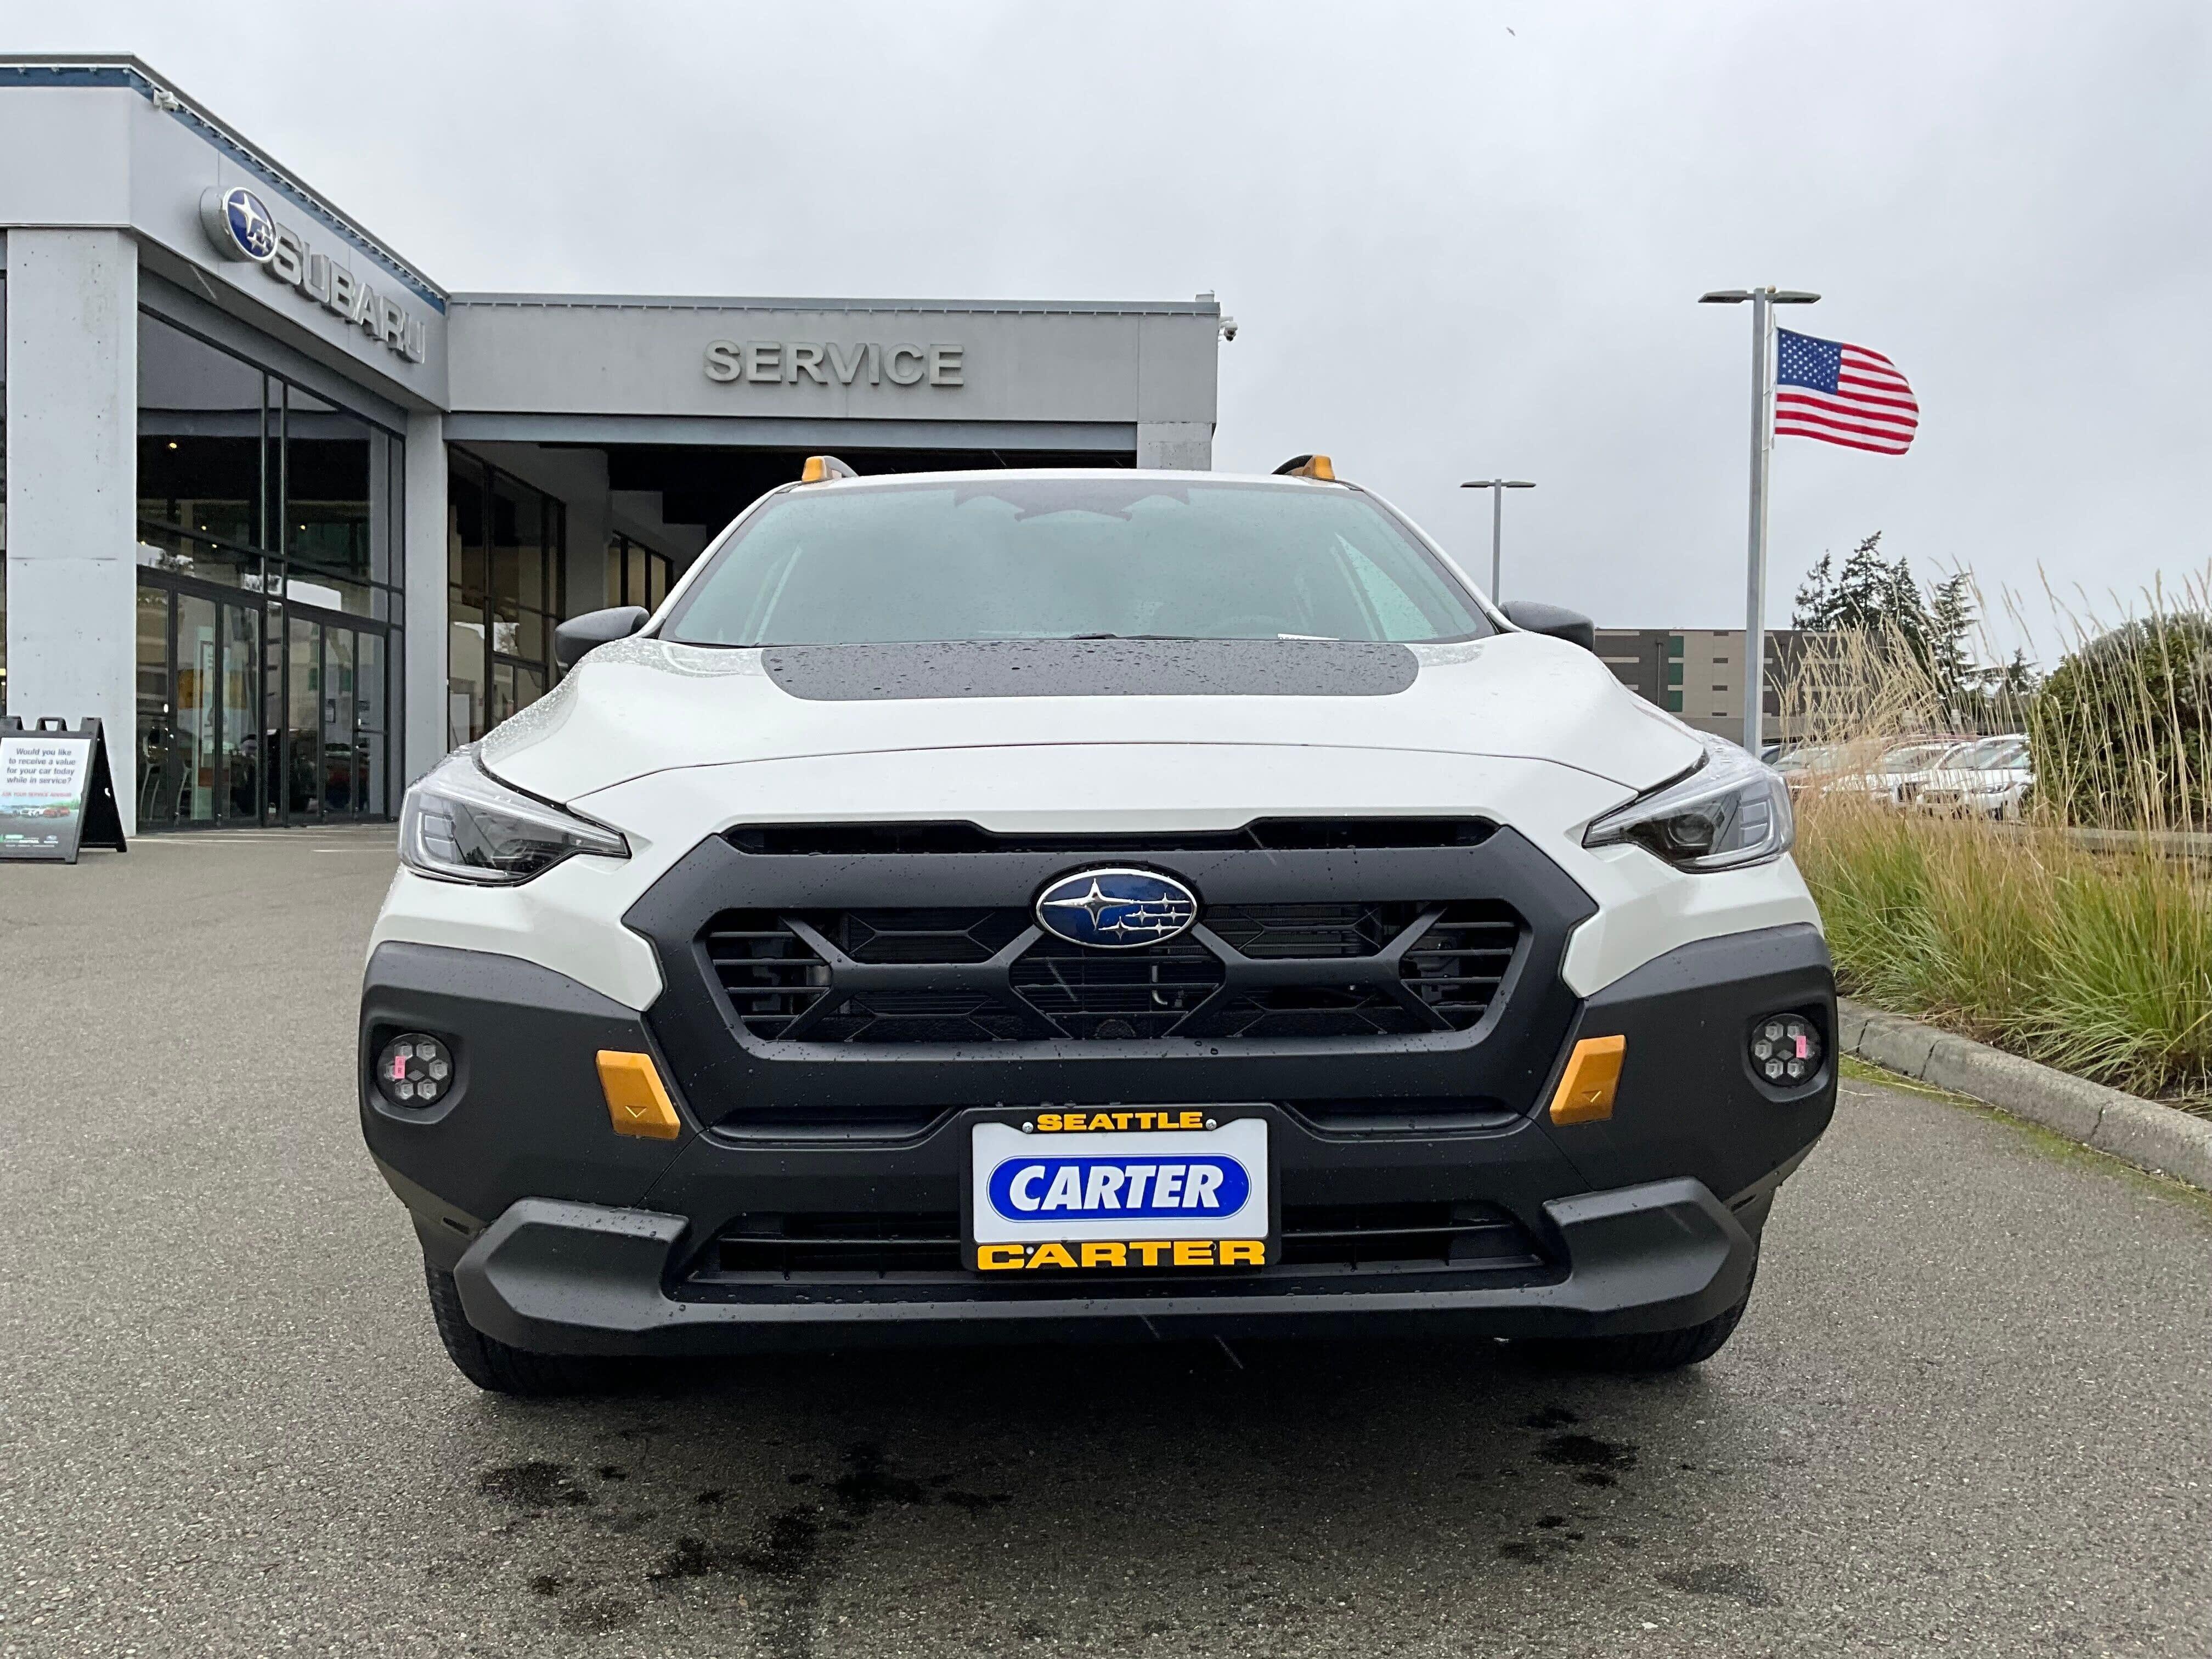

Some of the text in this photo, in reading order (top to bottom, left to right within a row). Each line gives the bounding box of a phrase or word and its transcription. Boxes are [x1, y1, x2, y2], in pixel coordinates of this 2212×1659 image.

[272, 222, 425, 364] SUBARU
[703, 339, 964, 386] SERVICE
[1037, 1111, 1203, 1131] SEATTLE
[1009, 1164, 1224, 1211] CARTER
[978, 1240, 1266, 1271] CARTER
